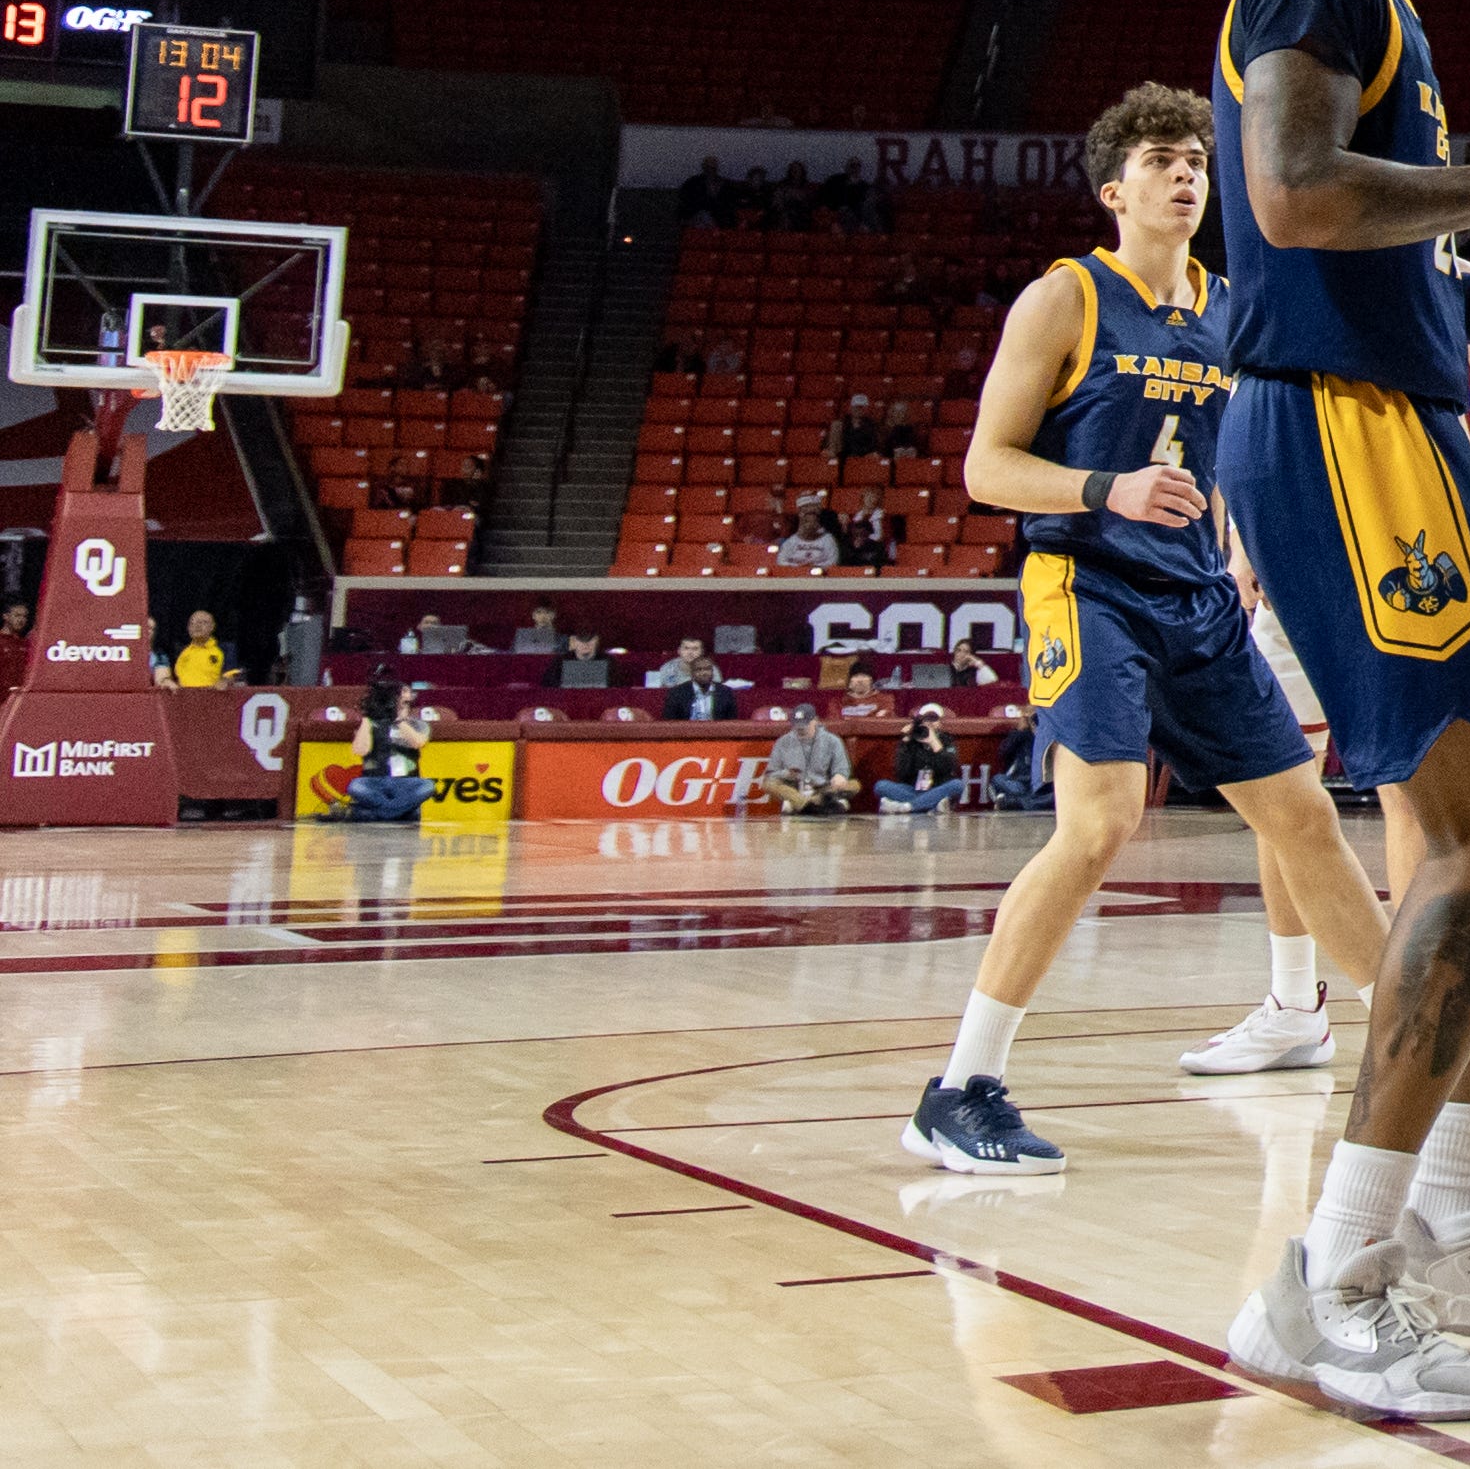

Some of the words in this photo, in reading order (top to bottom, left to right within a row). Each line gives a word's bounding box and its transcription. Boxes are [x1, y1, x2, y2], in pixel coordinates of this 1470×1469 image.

[4, 2, 46, 46] 13
[177, 73, 228, 129] 12
[1143, 378, 1215, 406] CITY
[1150, 413, 1184, 469] 4
[75, 538, 127, 597] OU
[47, 640, 131, 662] devon
[431, 776, 504, 803] ves
